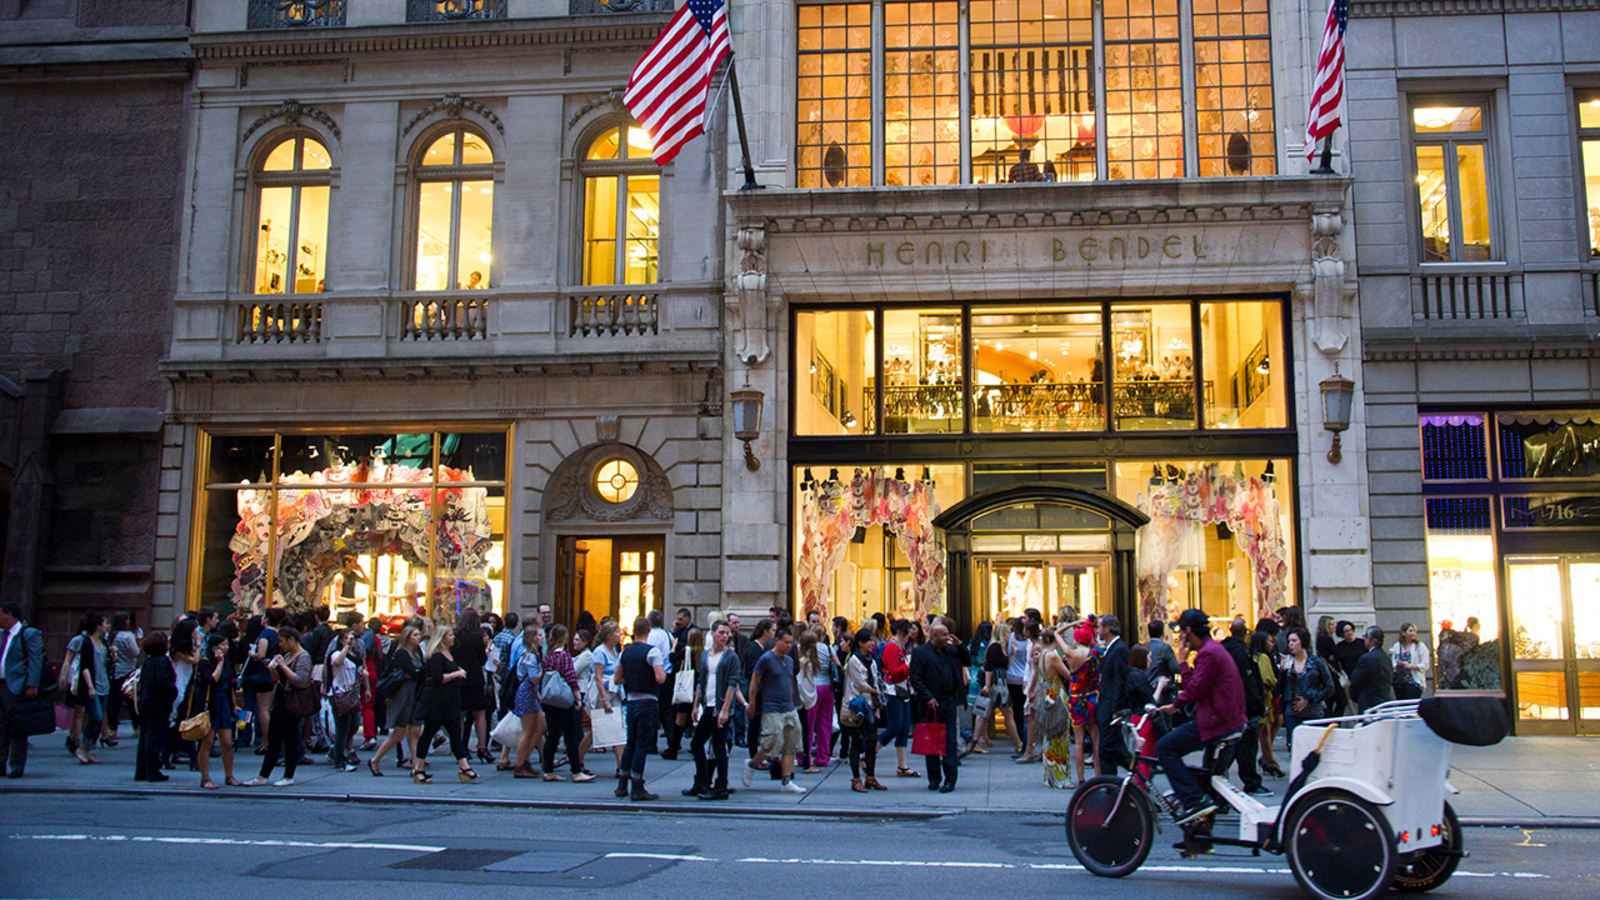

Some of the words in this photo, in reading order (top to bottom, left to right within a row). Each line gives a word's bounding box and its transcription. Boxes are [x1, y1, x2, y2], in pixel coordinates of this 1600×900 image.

[867, 240, 986, 265] HENRI
[1053, 235, 1207, 261] BENDEL
[1546, 504, 1574, 520] 716
